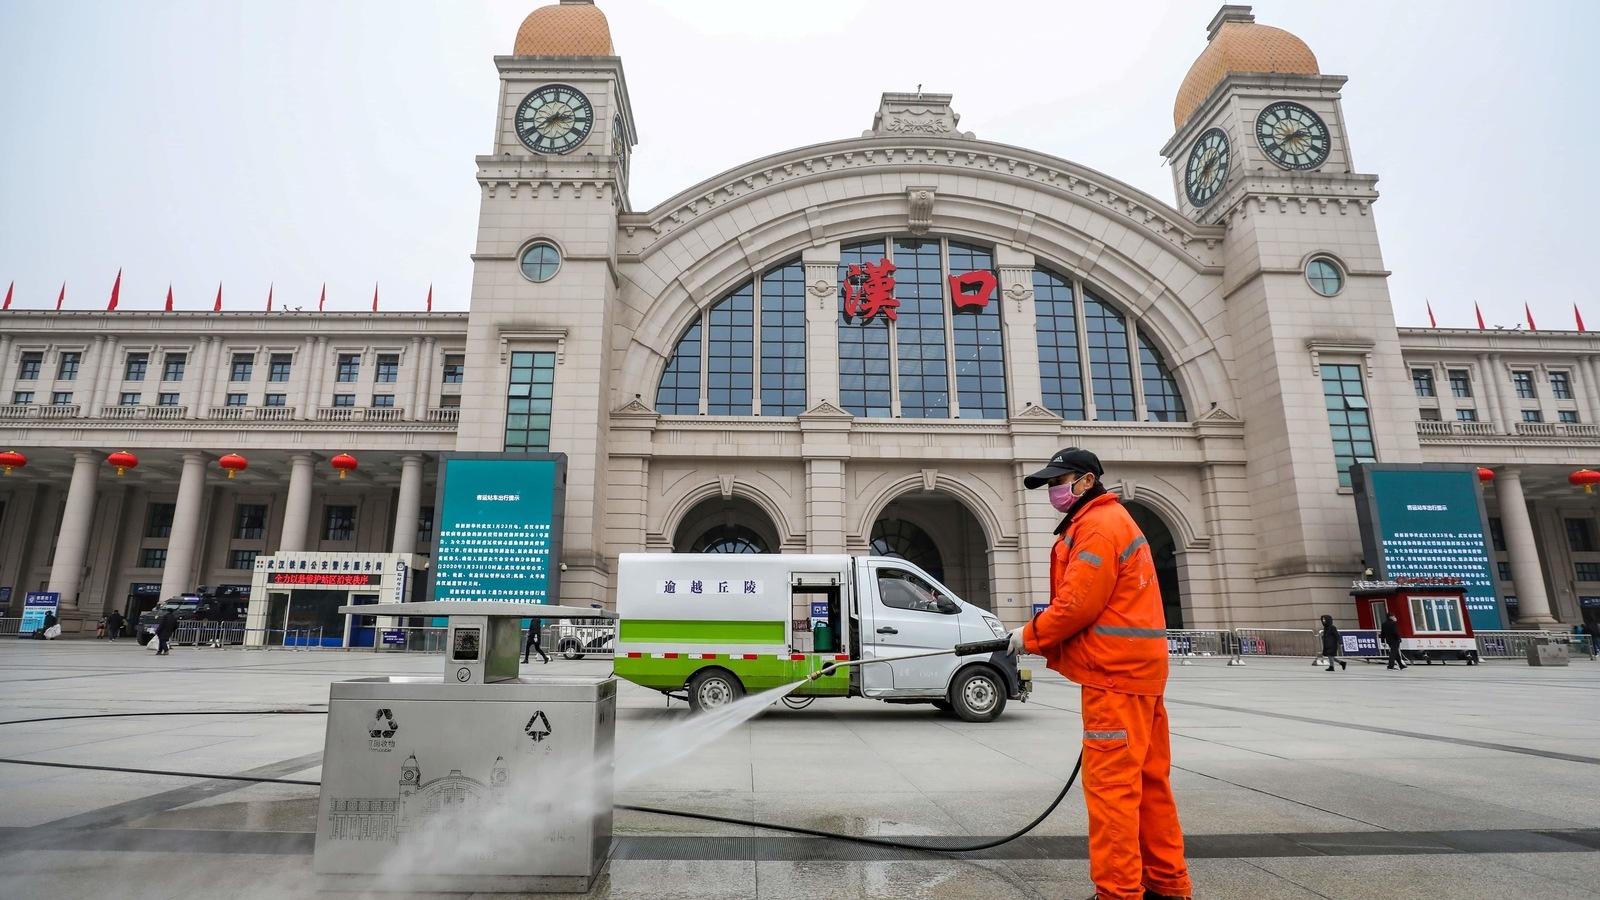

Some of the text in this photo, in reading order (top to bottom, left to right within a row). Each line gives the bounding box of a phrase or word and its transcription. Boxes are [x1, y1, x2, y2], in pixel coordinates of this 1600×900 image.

[843, 258, 997, 321] 漢口
[663, 580, 757, 594] 逾越丘陵
